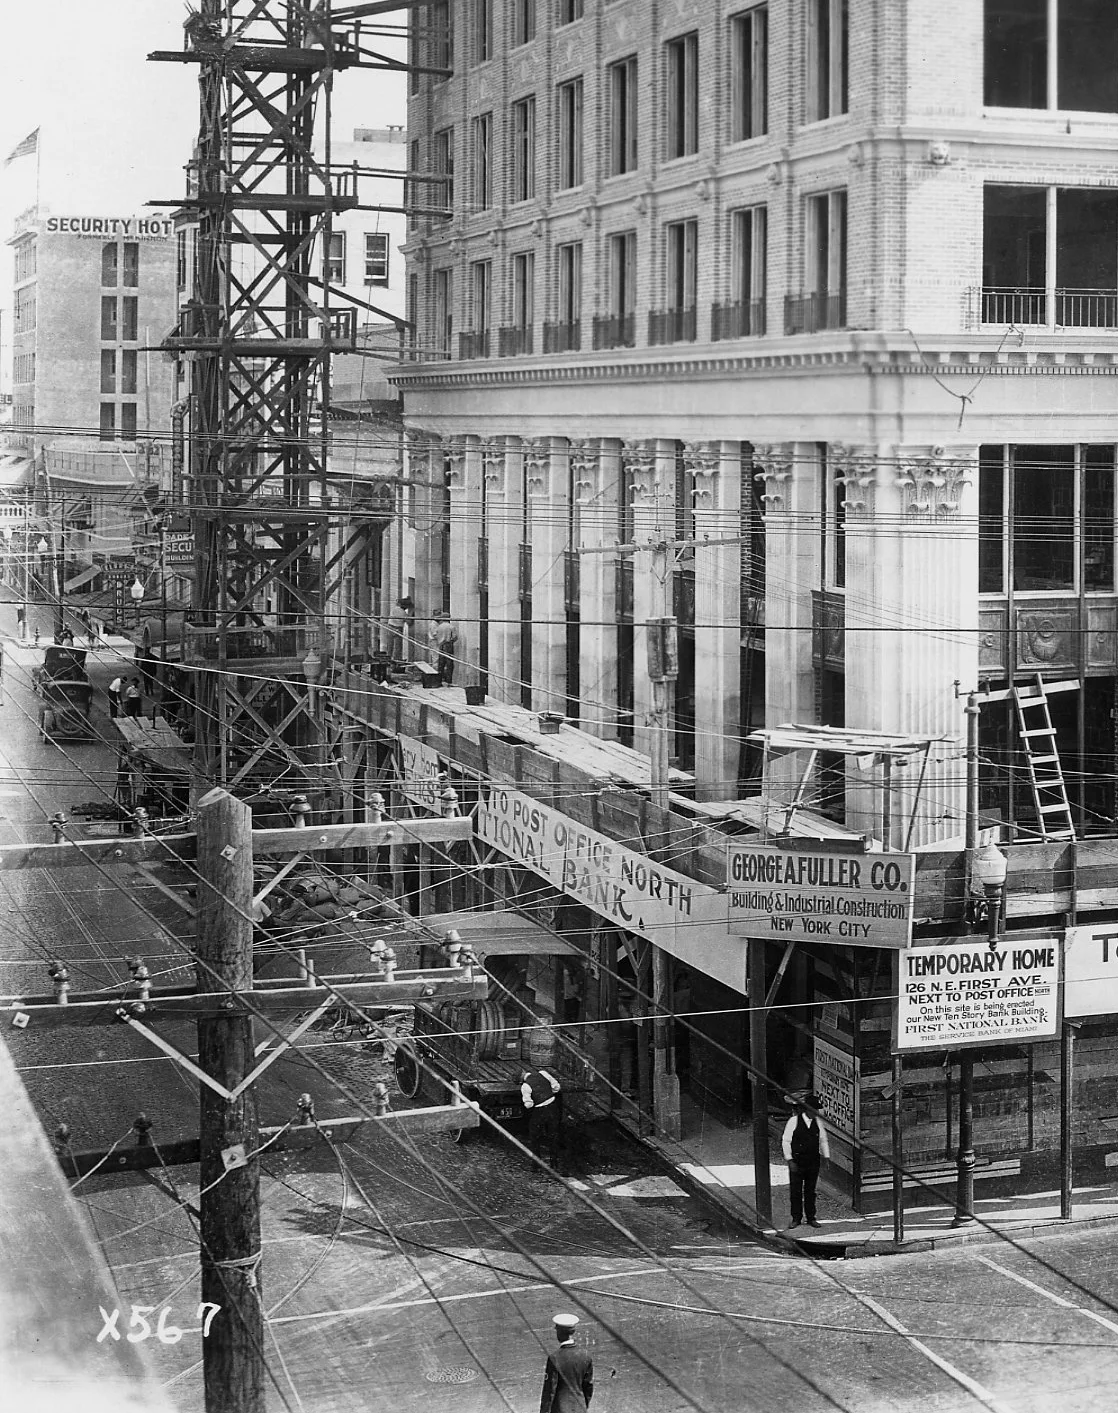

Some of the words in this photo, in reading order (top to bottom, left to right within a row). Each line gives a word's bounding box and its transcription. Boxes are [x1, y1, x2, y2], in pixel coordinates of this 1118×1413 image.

[47, 217, 131, 234] SECURITY
[138, 219, 172, 235] HOT
[165, 542, 191, 553] SECU
[479, 809, 551, 873] TIONAL
[492, 788, 508, 815] TO
[513, 799, 548, 837] POST
[554, 821, 613, 874] OFFICE
[621, 855, 692, 915] NORTH
[732, 853, 783, 884] GEORGE
[799, 856, 861, 889] FULLER
[871, 861, 908, 892] CO.
[732, 891, 773, 914] Building
[775, 893, 784, 912] &
[785, 893, 834, 915] Industrial
[771, 916, 794, 932] NEW
[801, 917, 832, 935] YORK
[838, 920, 872, 938] CITY
[906, 951, 1008, 977] TEMPORARY
[1012, 948, 1055, 970] HOME
[905, 983, 926, 994] 126
[959, 978, 1001, 991] FIRST
[1007, 974, 1047, 987] AVE.
[908, 993, 942, 1005] NEXT
[945, 992, 961, 1003] TO
[965, 990, 995, 1001] POST
[997, 987, 1034, 1000] OFFICE
[906, 1016, 921, 1024] our
[923, 1014, 941, 1022] New
[944, 1013, 960, 1021] Ten
[962, 1011, 985, 1022] Story
[988, 1008, 1009, 1018] Bank
[920, 1006, 933, 1015] On
[936, 1004, 951, 1014] this
[954, 1003, 971, 1012] site
[974, 1003, 981, 1011] is
[983, 1002, 1004, 1013] being
[1006, 1000, 1035, 1009] erected
[905, 1023, 944, 1034] FIRST
[948, 1020, 1008, 1031] NATIONAL
[1011, 1015, 1049, 1025] BANK
[938, 1031, 975, 1040] SERVICE
[977, 1029, 1001, 1037] BANK
